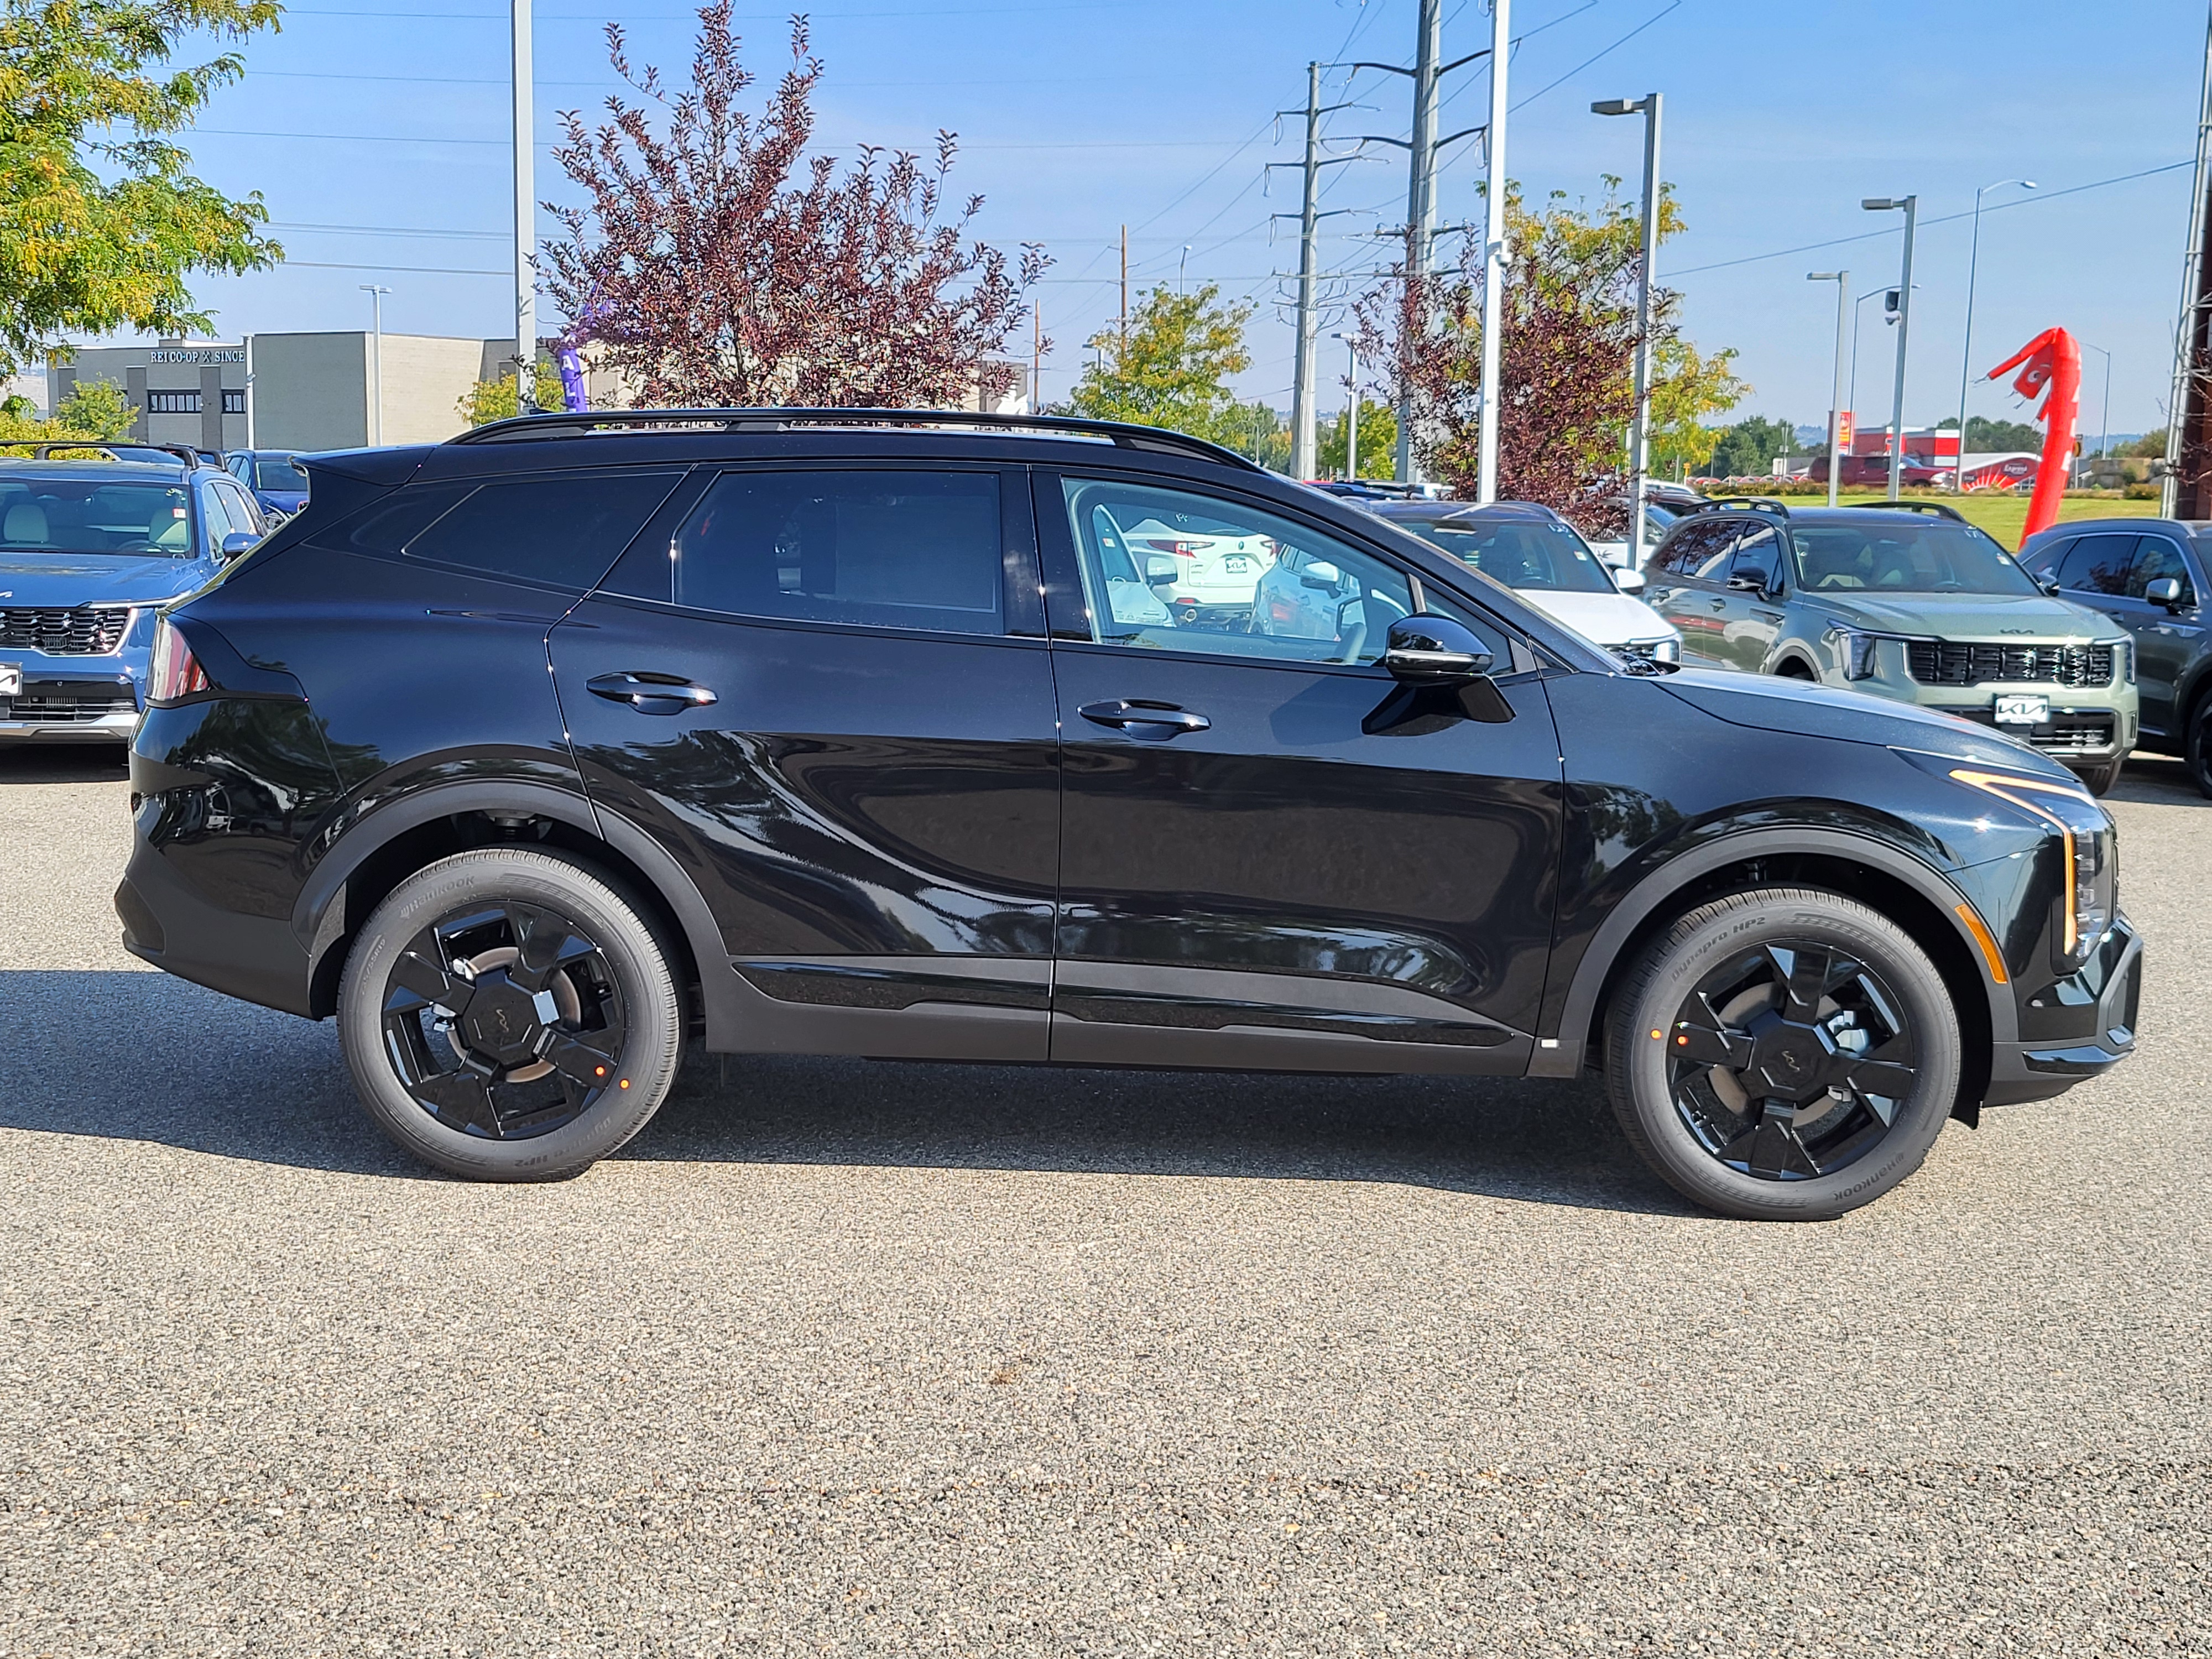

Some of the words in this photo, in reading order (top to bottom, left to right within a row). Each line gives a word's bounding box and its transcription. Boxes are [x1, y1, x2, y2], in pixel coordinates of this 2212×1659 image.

[150, 351, 168, 363] REI
[215, 351, 245, 363] SINCE
[1997, 702, 2047, 715] KIA
[409, 876, 474, 912] Hankook
[1733, 916, 1766, 933] HP2
[1833, 1159, 1897, 1201] Hankook
